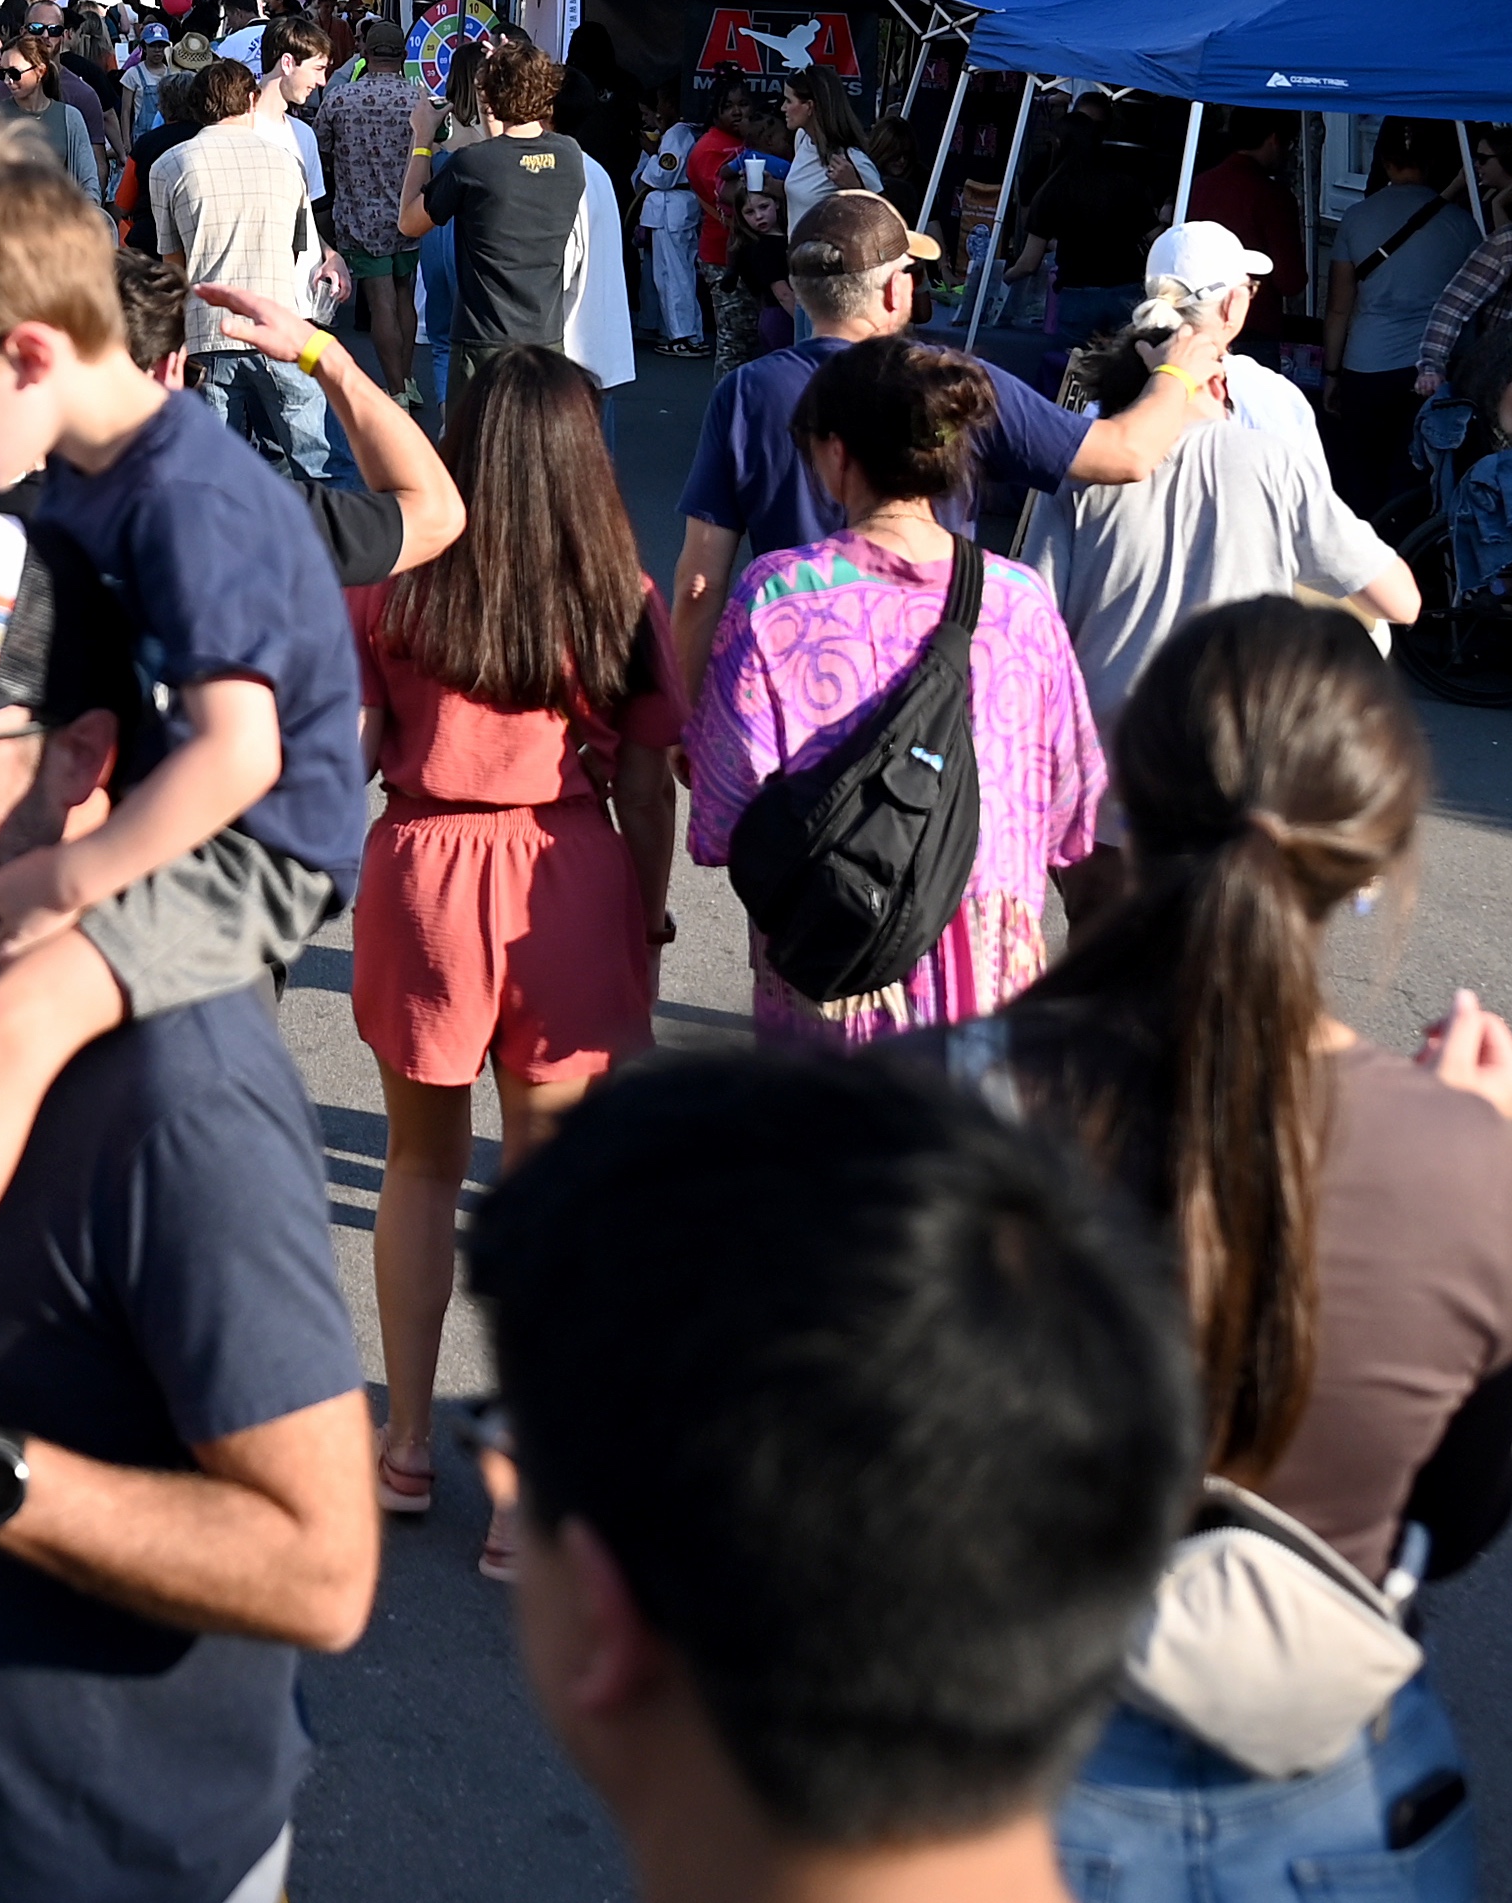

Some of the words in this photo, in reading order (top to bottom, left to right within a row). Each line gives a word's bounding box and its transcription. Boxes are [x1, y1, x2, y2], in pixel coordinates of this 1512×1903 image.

[436, 3, 447, 15] 10
[470, 3, 480, 14] 10
[409, 35, 421, 47] 10
[696, 7, 862, 78] ATA
[693, 76, 784, 93] MTIA
